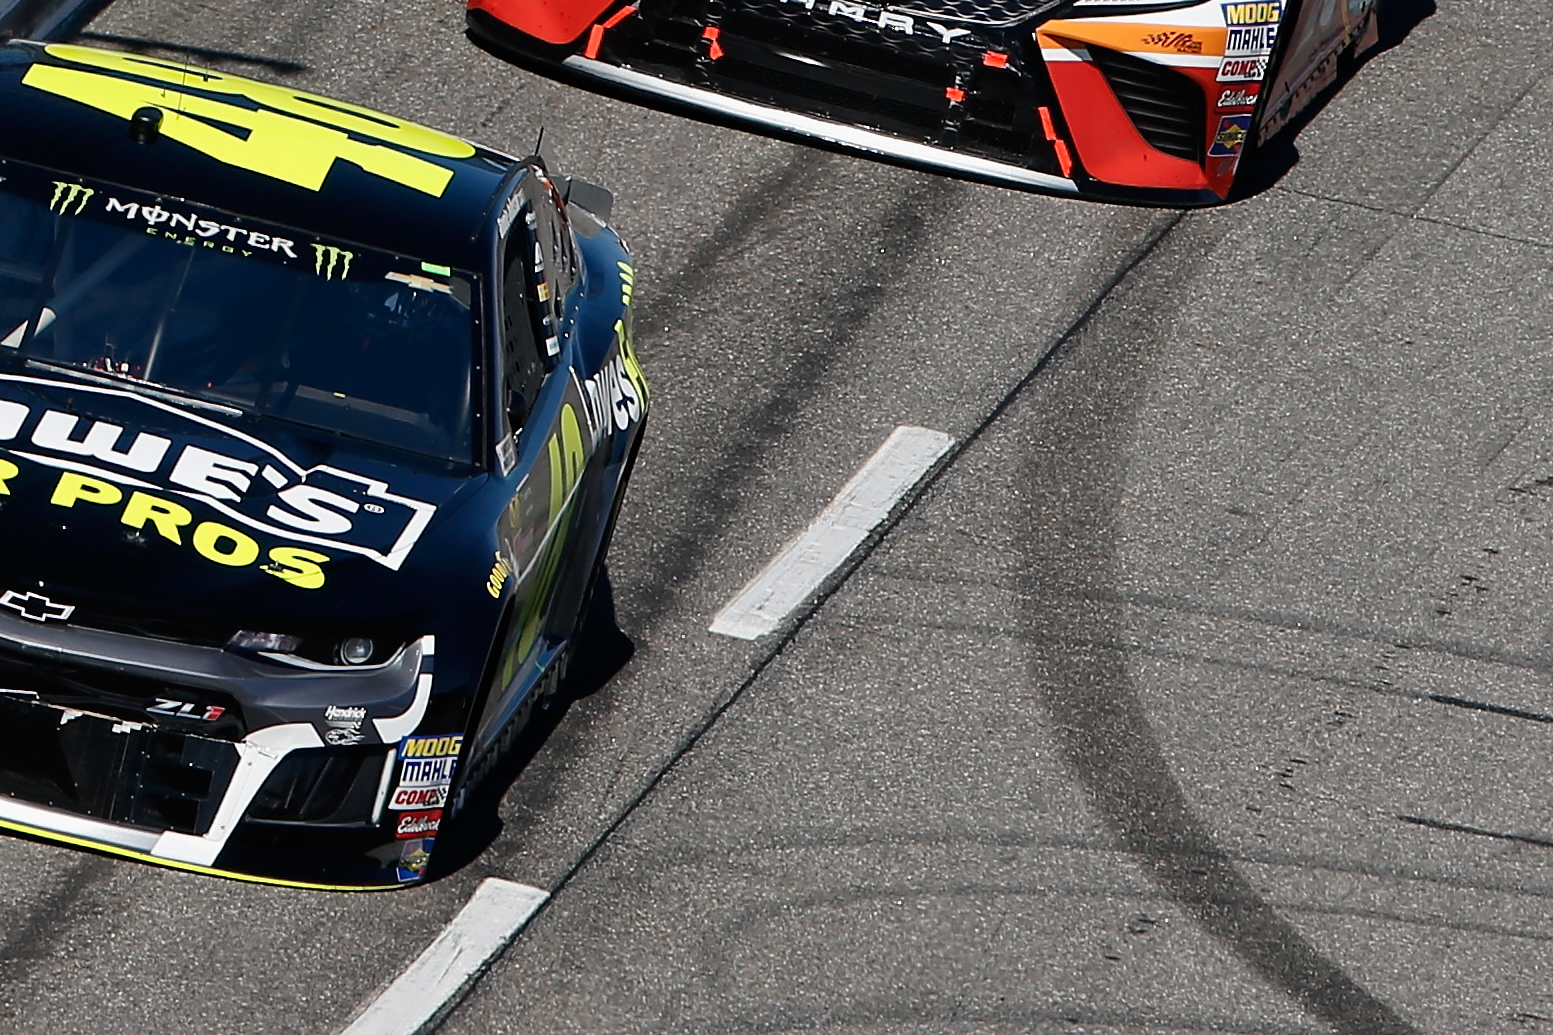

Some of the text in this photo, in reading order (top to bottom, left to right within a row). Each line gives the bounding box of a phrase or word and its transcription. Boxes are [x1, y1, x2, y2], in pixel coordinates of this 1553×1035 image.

[1227, 2, 1280, 25] MOOG
[21, 44, 476, 198] 48
[105, 197, 297, 258] MONSTER
[146, 227, 252, 257] ENERGY
[50, 471, 332, 589] PROS
[146, 697, 226, 721] ZL1
[401, 736, 464, 757] MOOG
